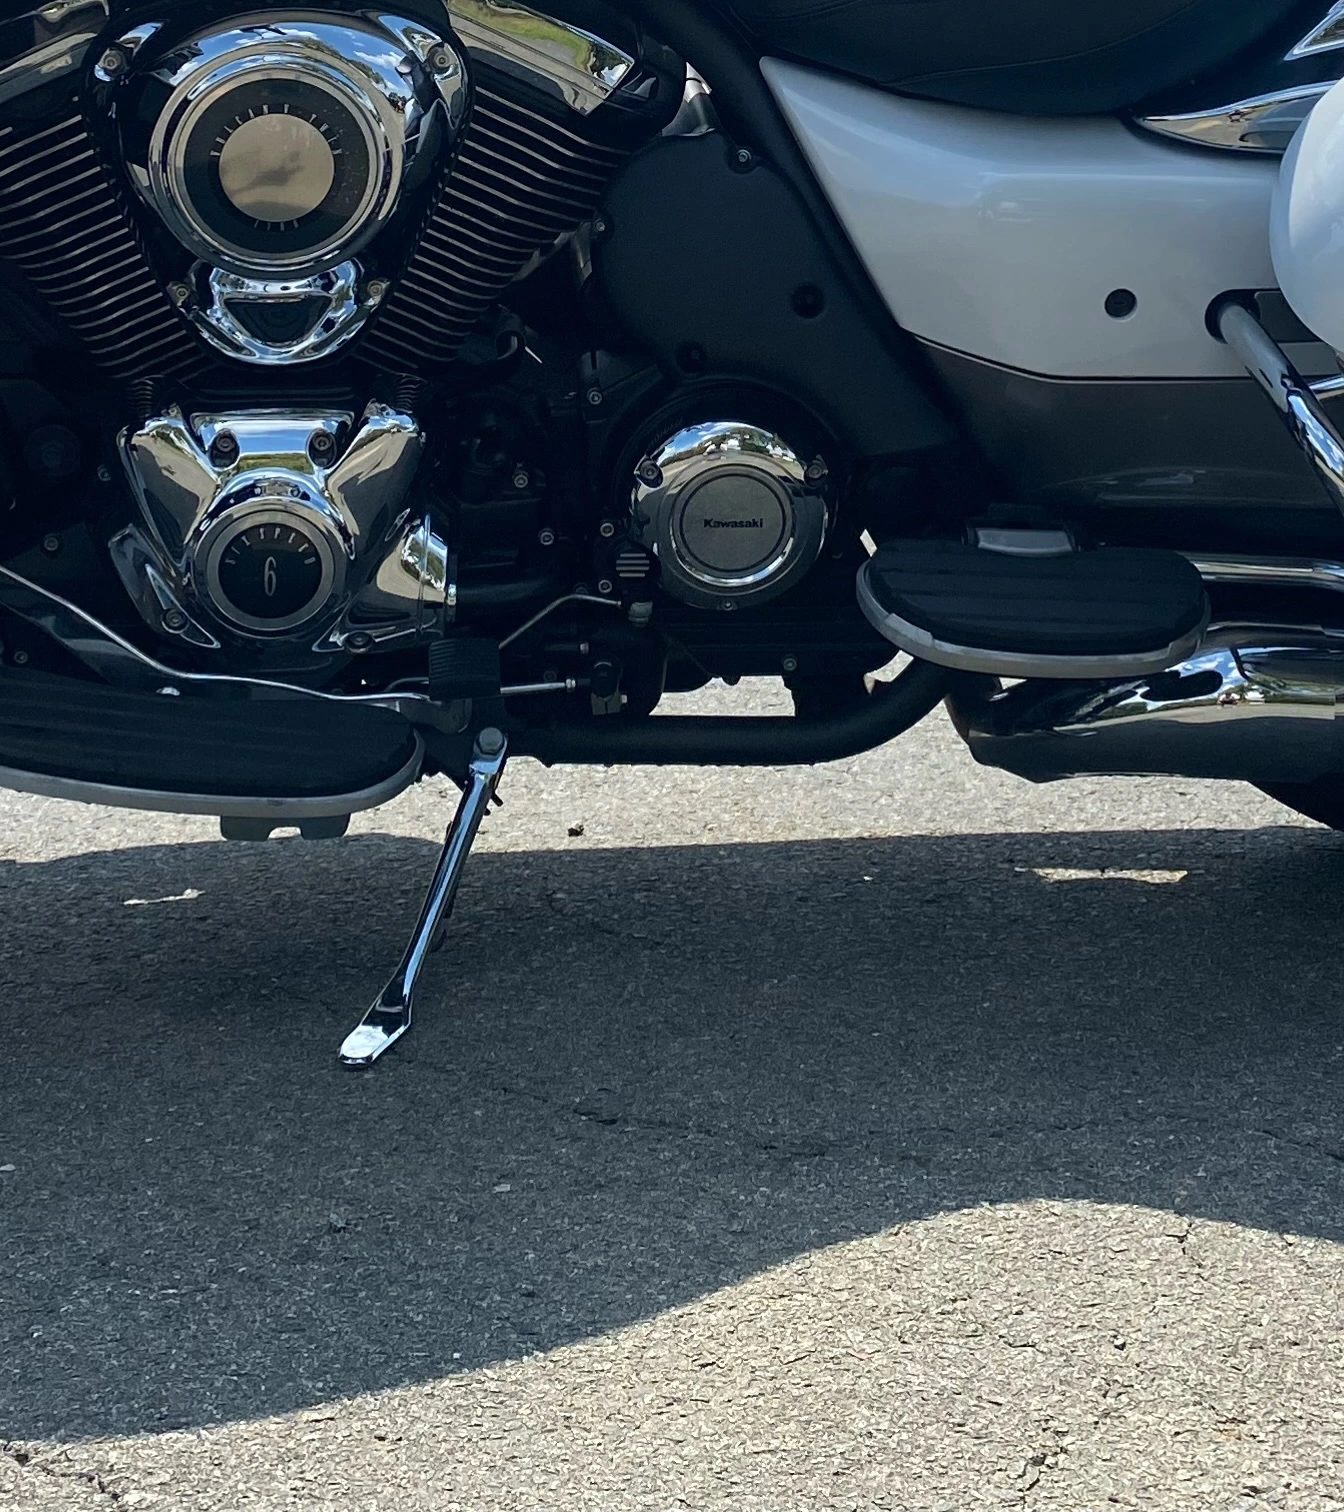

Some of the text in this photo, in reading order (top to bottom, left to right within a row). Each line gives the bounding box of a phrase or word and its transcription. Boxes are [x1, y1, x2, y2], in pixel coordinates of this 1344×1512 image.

[210, 103, 269, 156] VULCAN
[703, 518, 764, 528] Kawasaki
[224, 527, 316, 565] SIX SPEED
[264, 556, 277, 597] 6
